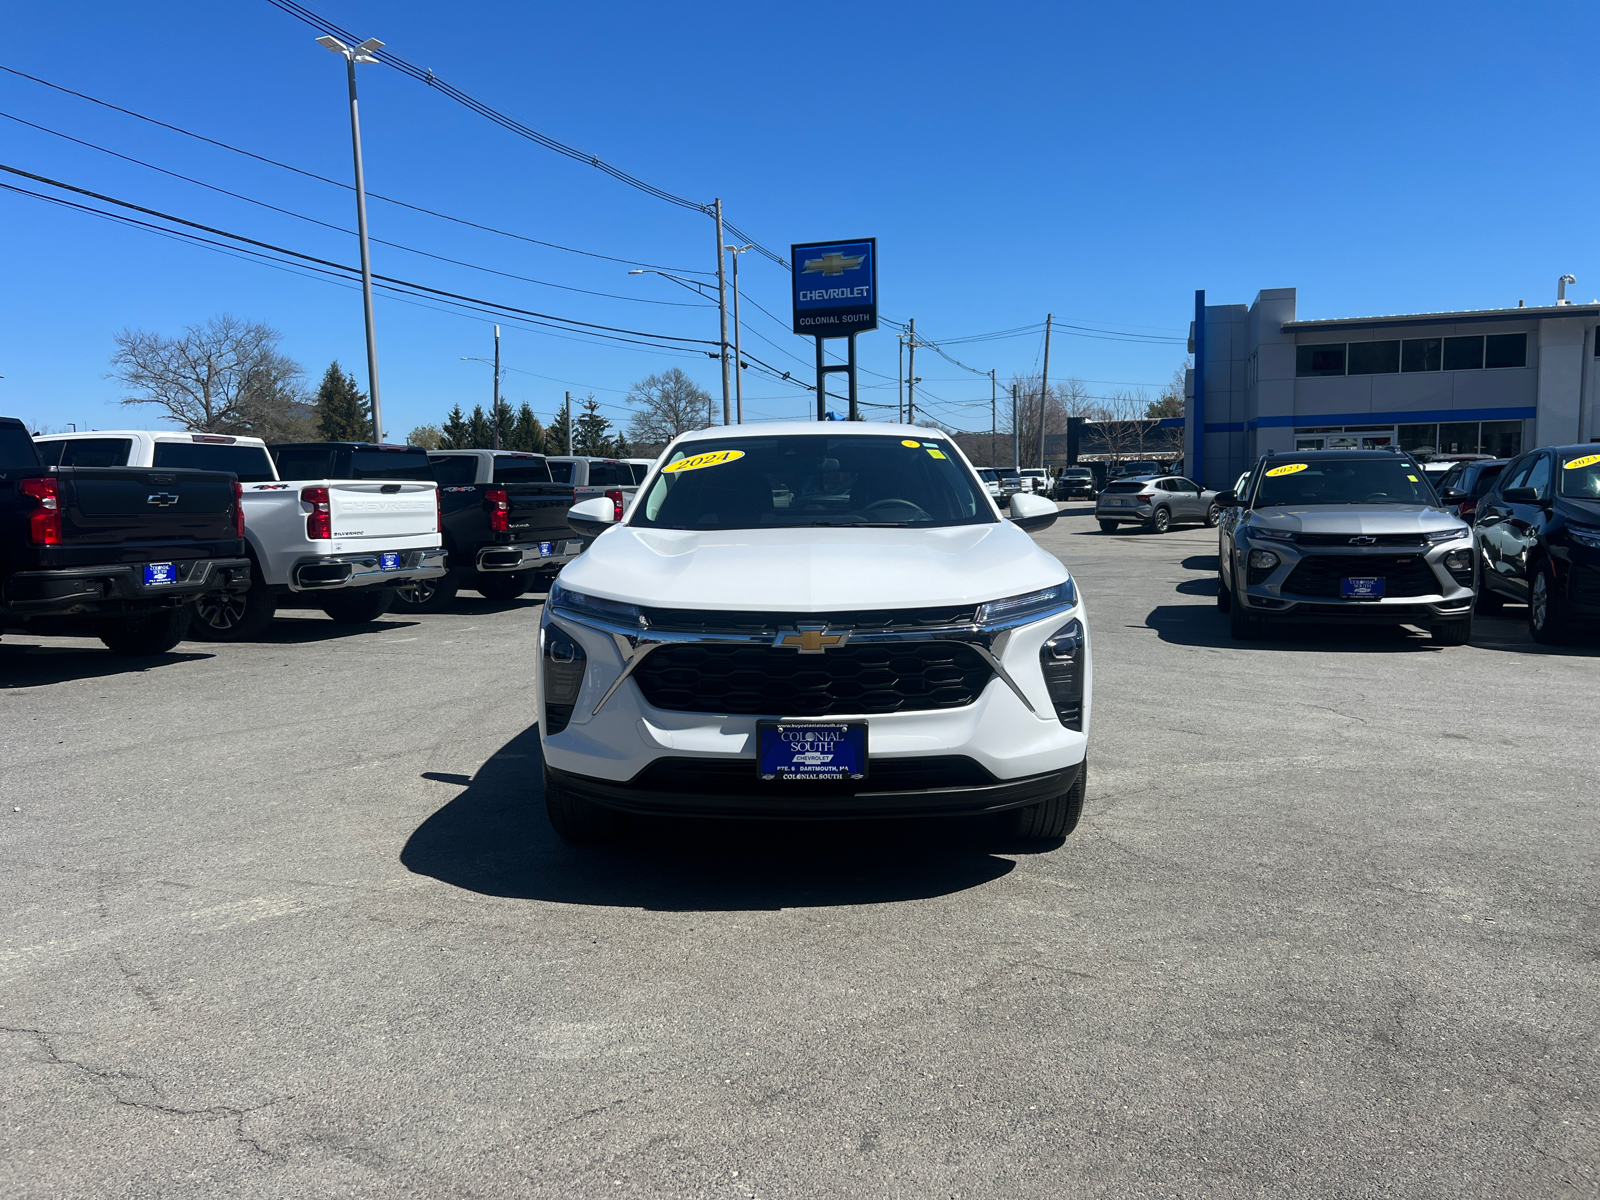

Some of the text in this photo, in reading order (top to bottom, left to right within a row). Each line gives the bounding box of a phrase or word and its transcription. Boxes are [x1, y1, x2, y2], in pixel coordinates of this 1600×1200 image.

[800, 286, 869, 301] CHEVROLET
[800, 313, 870, 326] COLONIAL SOUTH
[675, 452, 731, 470] 2024
[781, 732, 845, 742] COLONIAL
[790, 742, 835, 752] SOUTH
